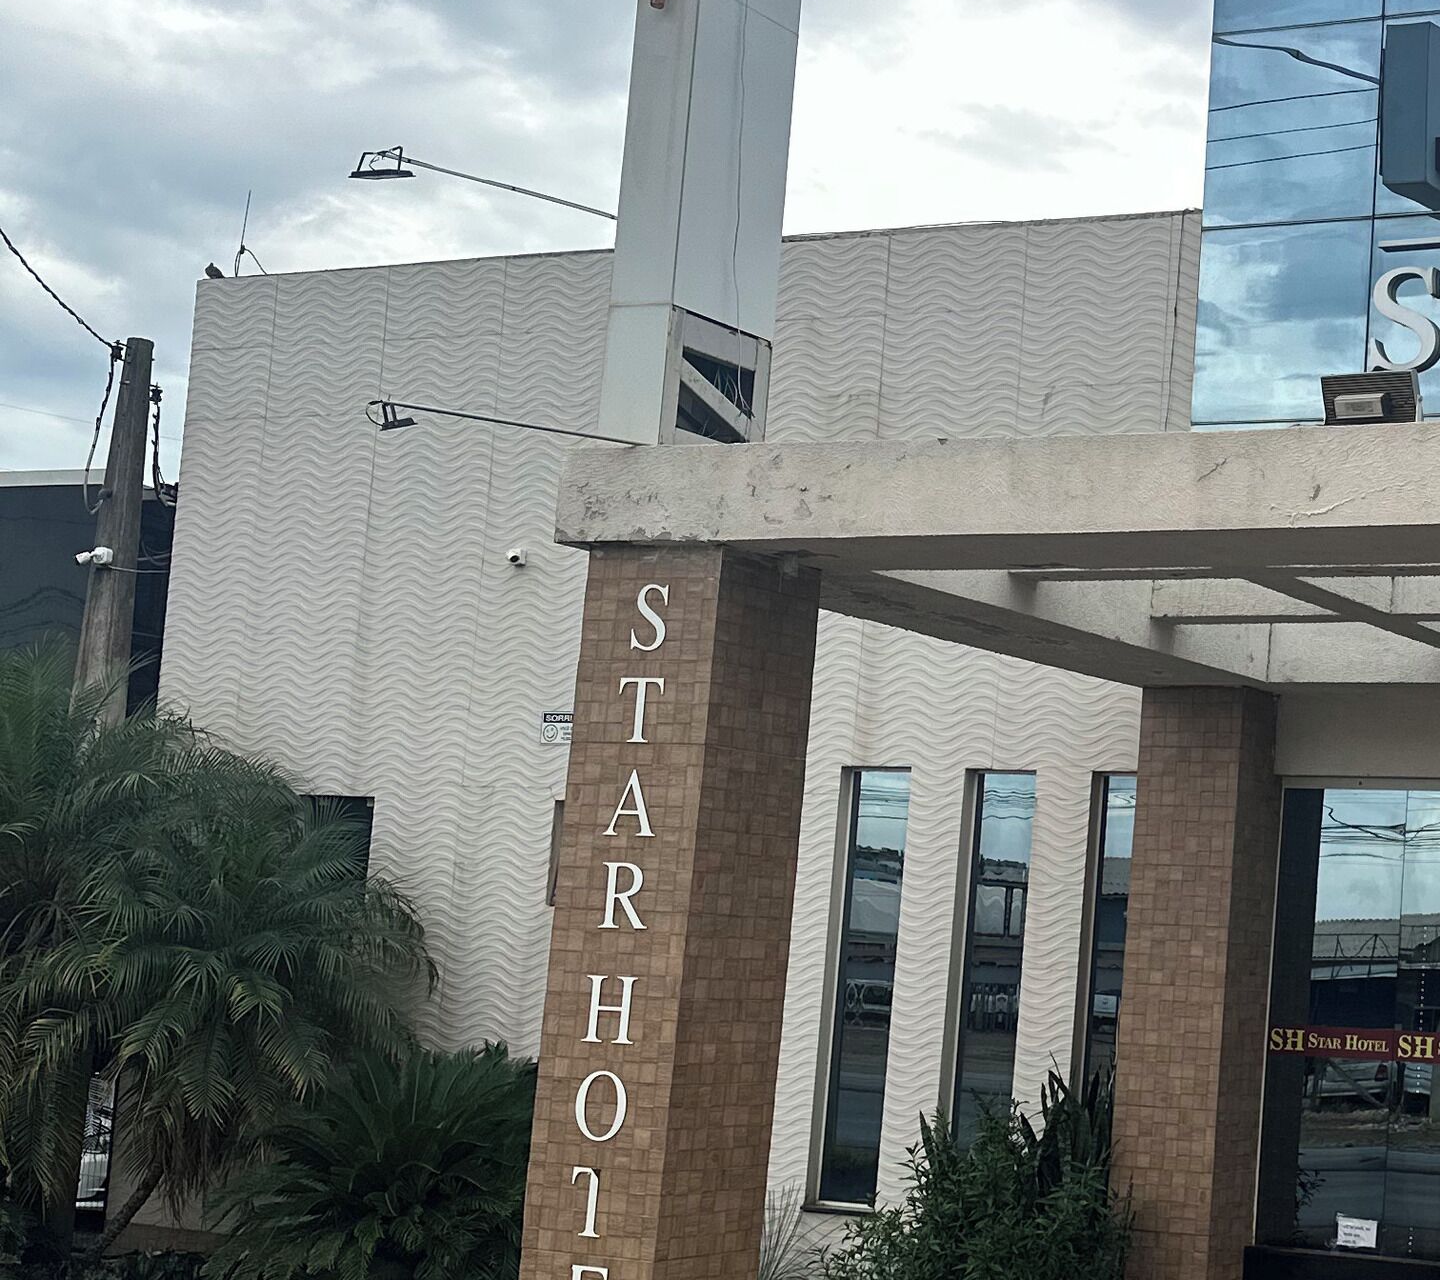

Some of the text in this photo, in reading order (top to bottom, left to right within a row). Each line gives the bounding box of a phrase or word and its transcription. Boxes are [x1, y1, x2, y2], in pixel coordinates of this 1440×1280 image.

[597, 584, 669, 930] STAR
[1270, 1028, 1389, 1052] SH STAR HOTEL
[1398, 1035, 1435, 1058] SH
